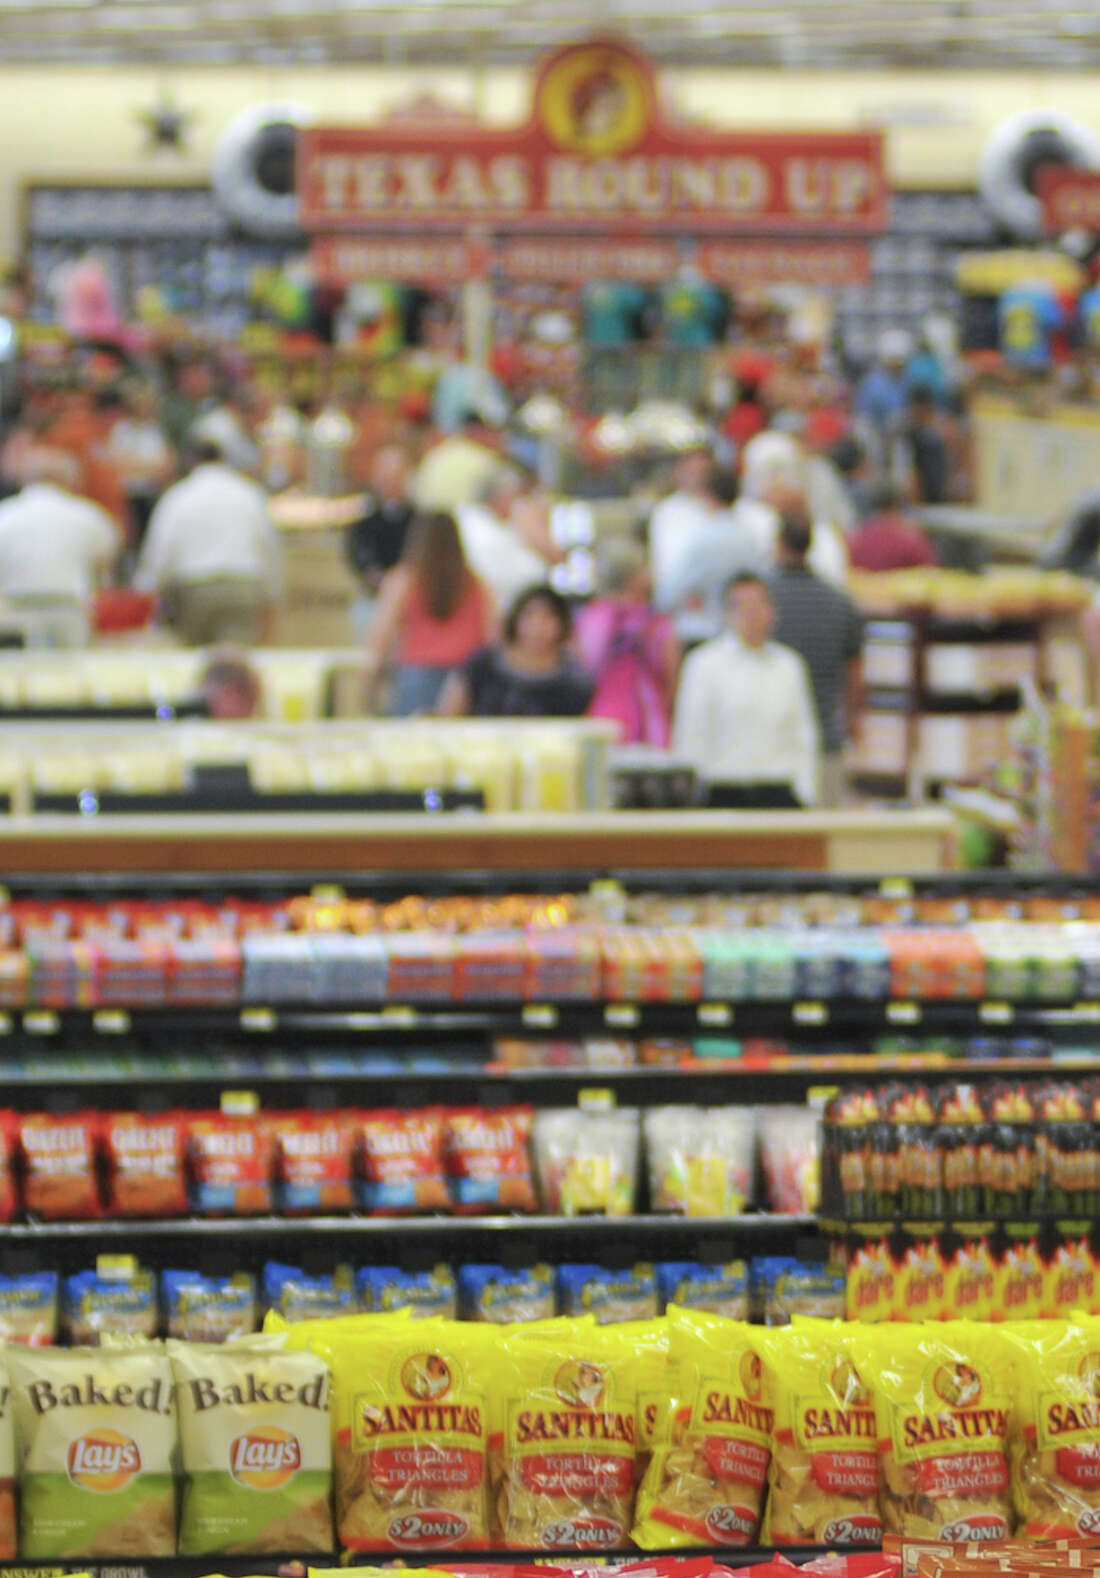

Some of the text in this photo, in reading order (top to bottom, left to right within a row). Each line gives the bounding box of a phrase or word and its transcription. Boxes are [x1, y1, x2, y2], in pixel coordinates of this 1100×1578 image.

[321, 154, 872, 217] TEXAS ROUND UP
[29, 1373, 175, 1415] Baked!
[190, 1372, 333, 1412] Baked!
[362, 1404, 482, 1437] SANTITAS
[517, 1410, 634, 1444] SANTITAS
[904, 1409, 1009, 1448] SANTITA
[74, 1437, 138, 1475] Lay's
[235, 1436, 299, 1474] Lay's
[392, 1450, 463, 1465] TORTILLA
[387, 1468, 468, 1483] TRIANGLES
[421, 1518, 465, 1537] ONLY
